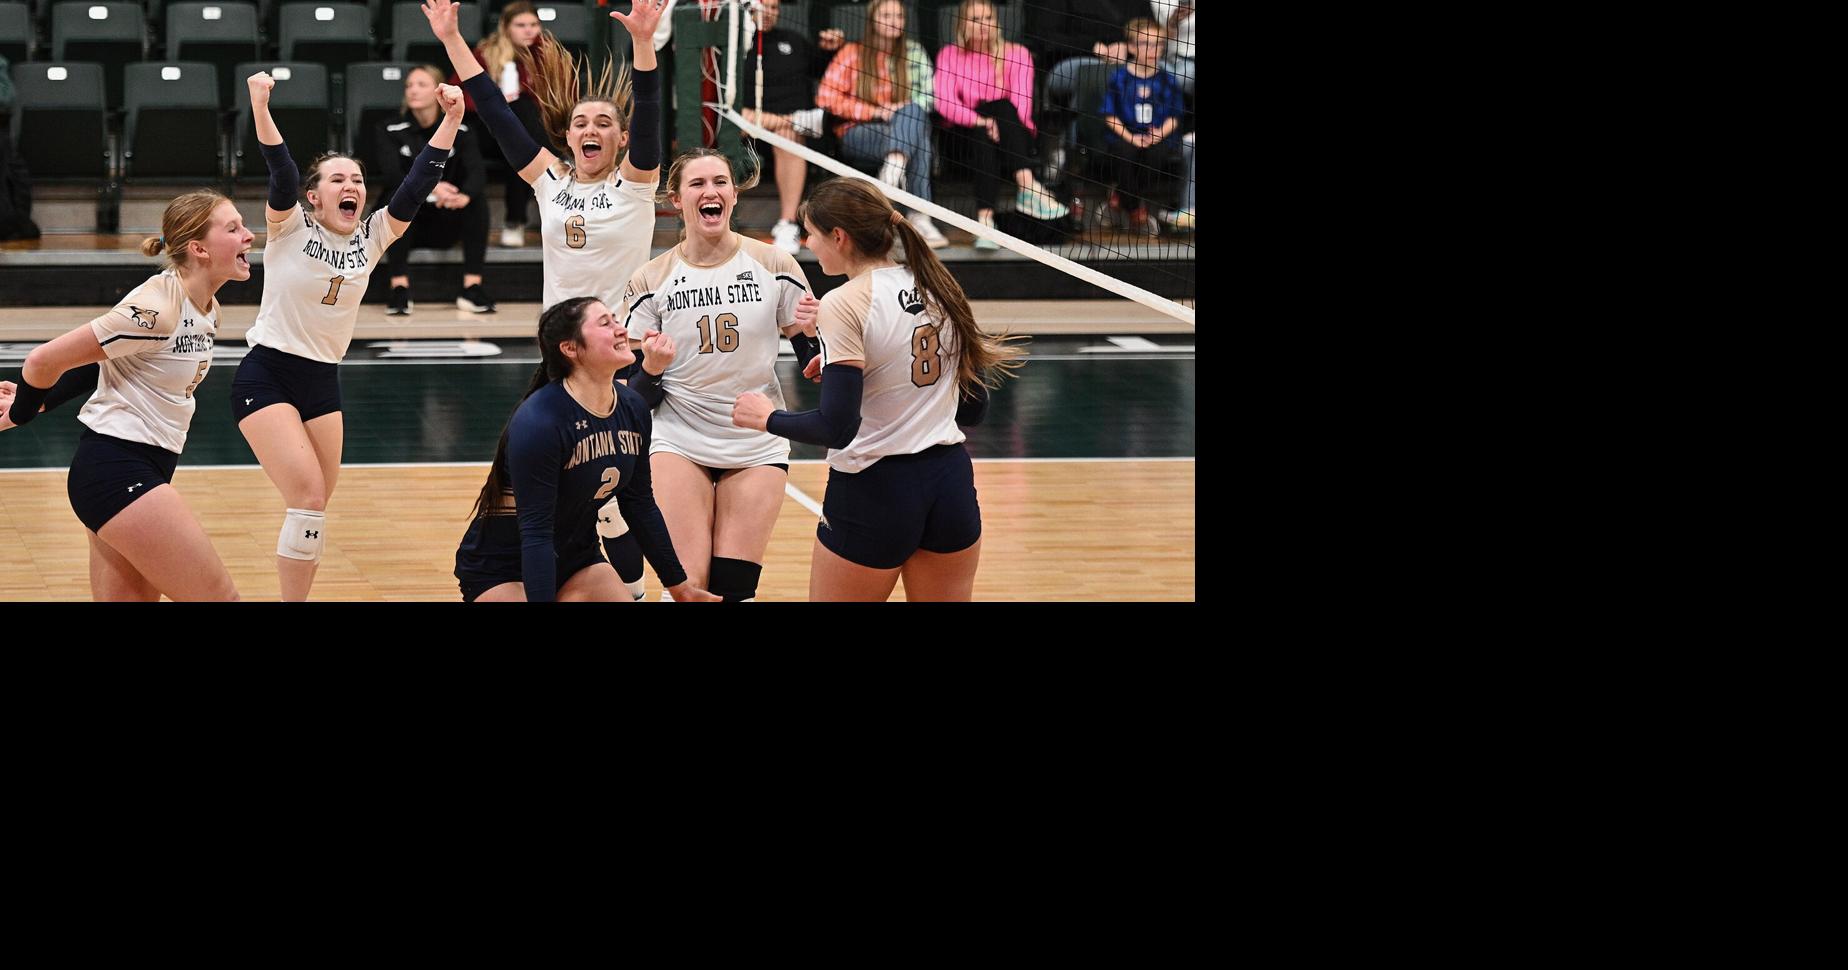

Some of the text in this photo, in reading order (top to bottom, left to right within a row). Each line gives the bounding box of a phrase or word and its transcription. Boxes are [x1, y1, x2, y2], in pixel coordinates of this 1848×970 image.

[564, 214, 587, 249] 6
[321, 274, 345, 305] 1
[667, 283, 762, 312] MONTANA STATE
[696, 312, 740, 354] 16
[911, 323, 941, 388] 8
[618, 430, 643, 456] STAT
[593, 466, 620, 500] 2
